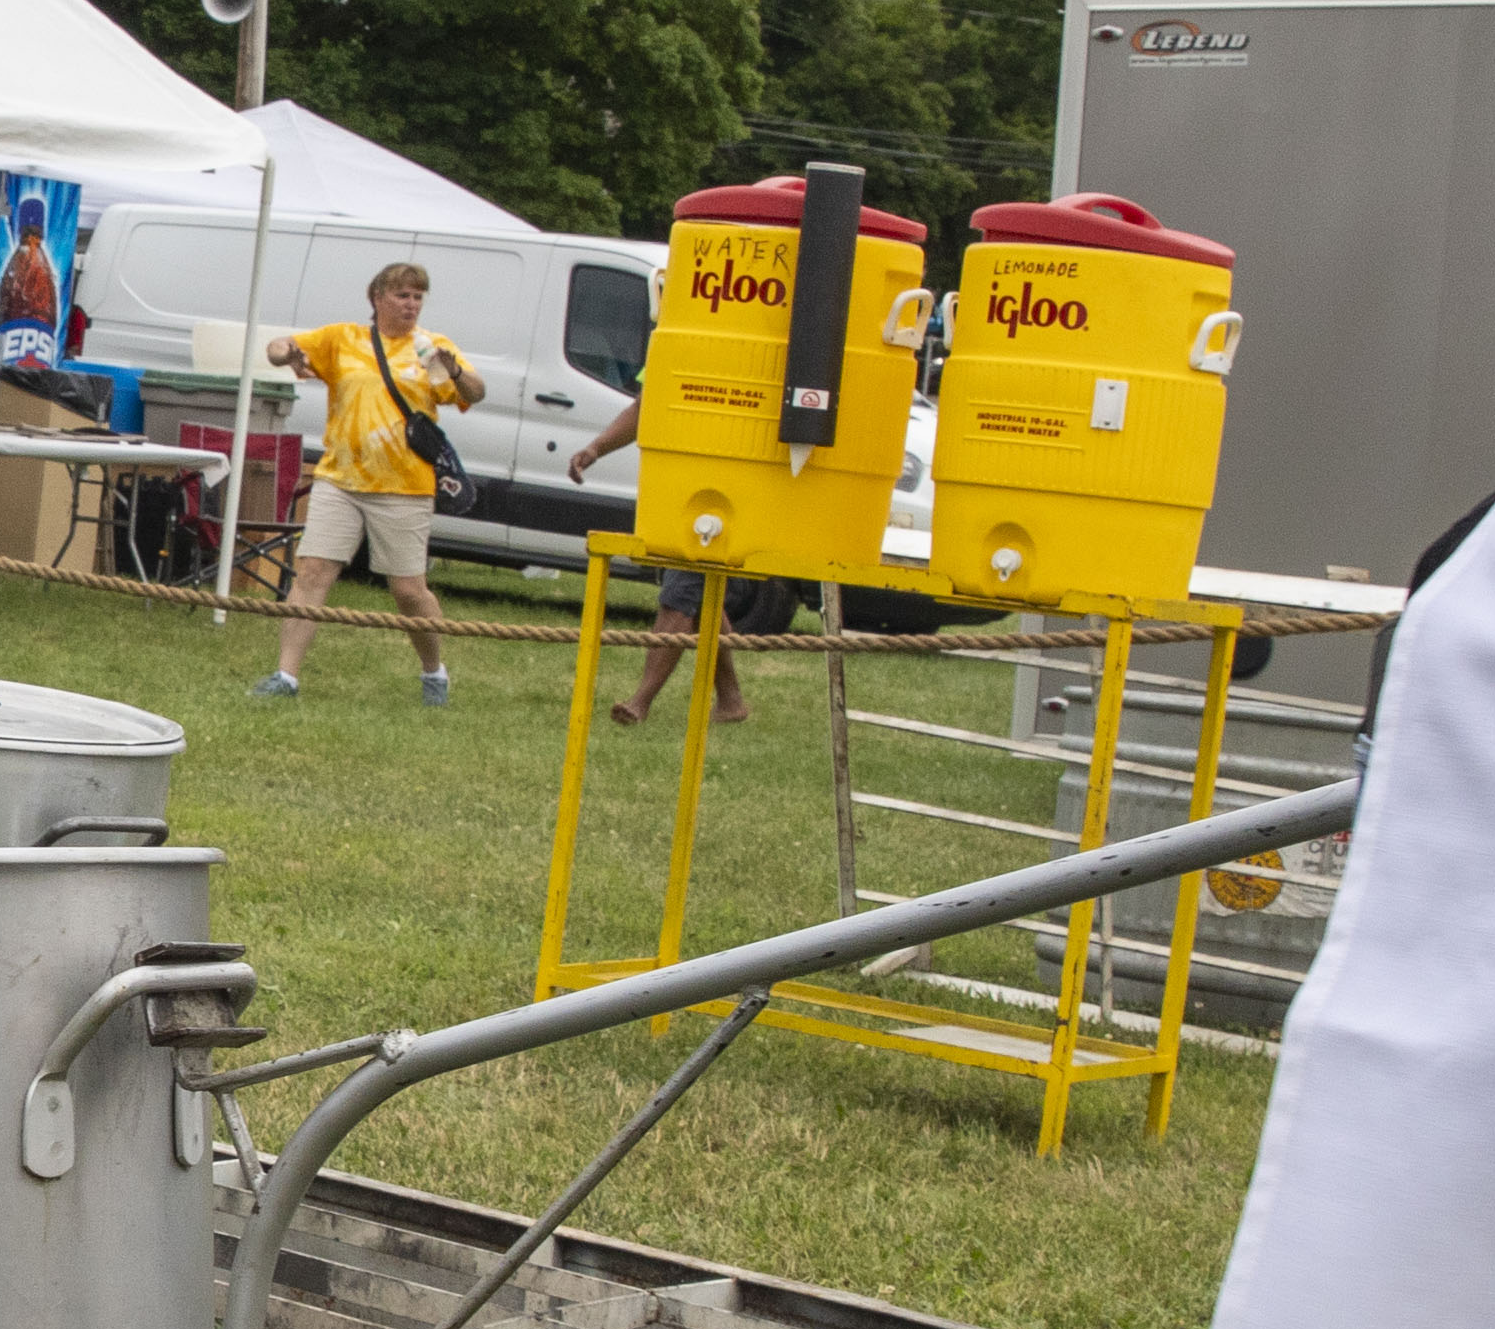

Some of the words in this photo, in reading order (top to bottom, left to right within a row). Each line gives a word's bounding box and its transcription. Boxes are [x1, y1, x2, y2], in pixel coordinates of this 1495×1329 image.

[1142, 31, 1249, 50] LEGEND
[693, 236, 791, 278] WATER
[993, 259, 1079, 278] LEMONADE
[681, 382, 727, 395] INDUSTRIAL
[731, 388, 767, 400] 10-GAL.
[683, 393, 726, 405] DRINKING
[728, 399, 760, 409] WATER
[977, 411, 1027, 423] INDUSTRIAL
[1030, 416, 1068, 428] 10-GAL.
[980, 422, 1025, 433] DRINKING
[1028, 427, 1060, 438] WATER
